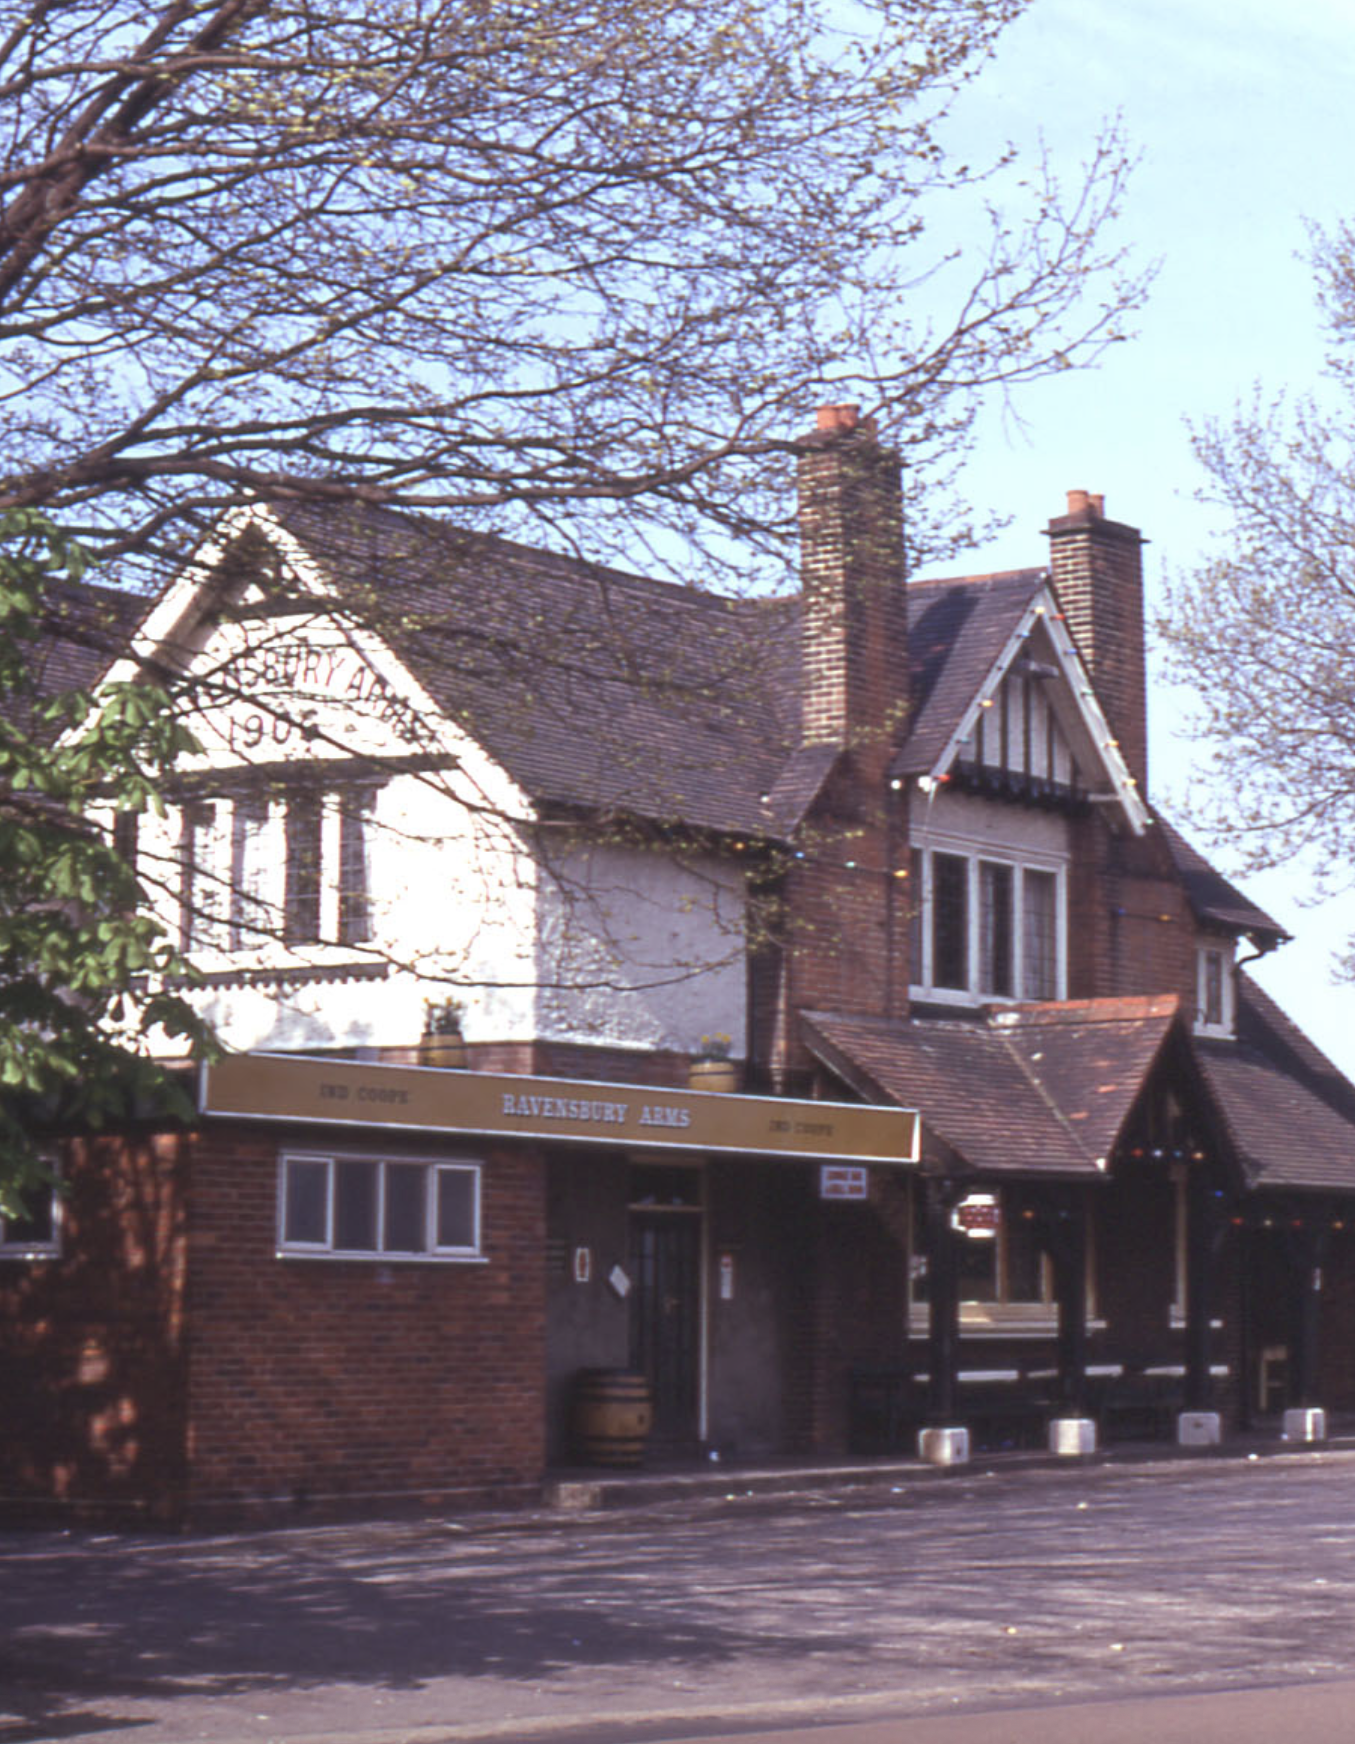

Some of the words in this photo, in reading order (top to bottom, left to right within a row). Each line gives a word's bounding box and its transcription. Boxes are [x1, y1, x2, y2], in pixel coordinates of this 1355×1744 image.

[358, 1086, 409, 1105] COOPE
[502, 1093, 628, 1124] RAVENSBURY
[637, 1104, 691, 1128] ARMS
